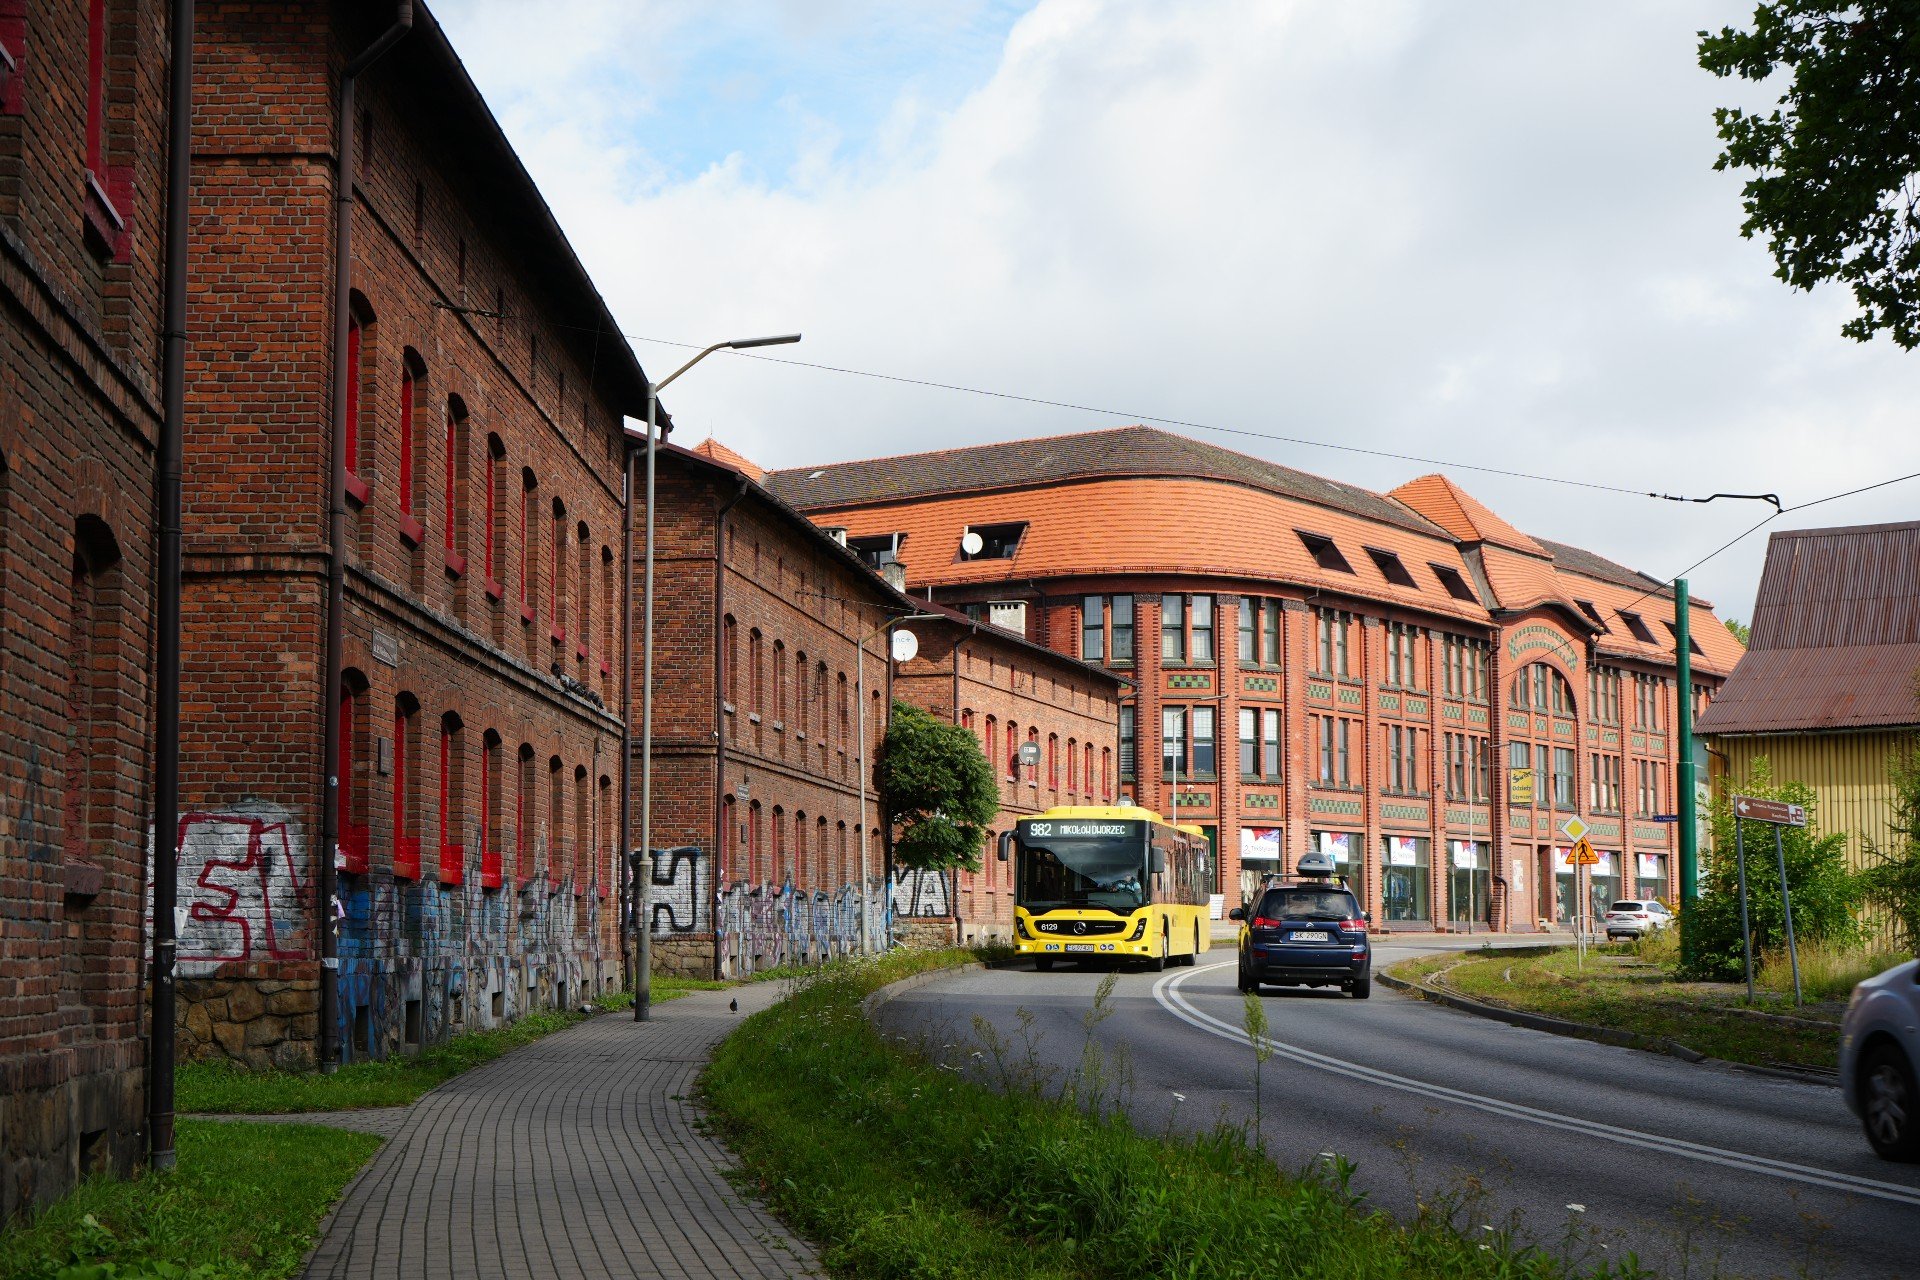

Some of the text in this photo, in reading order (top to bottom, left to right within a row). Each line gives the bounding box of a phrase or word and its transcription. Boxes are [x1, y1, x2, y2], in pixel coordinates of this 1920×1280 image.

[1030, 823, 1052, 837] 982
[1091, 824, 1126, 835] DWORZEC
[1041, 923, 1058, 931] 6129
